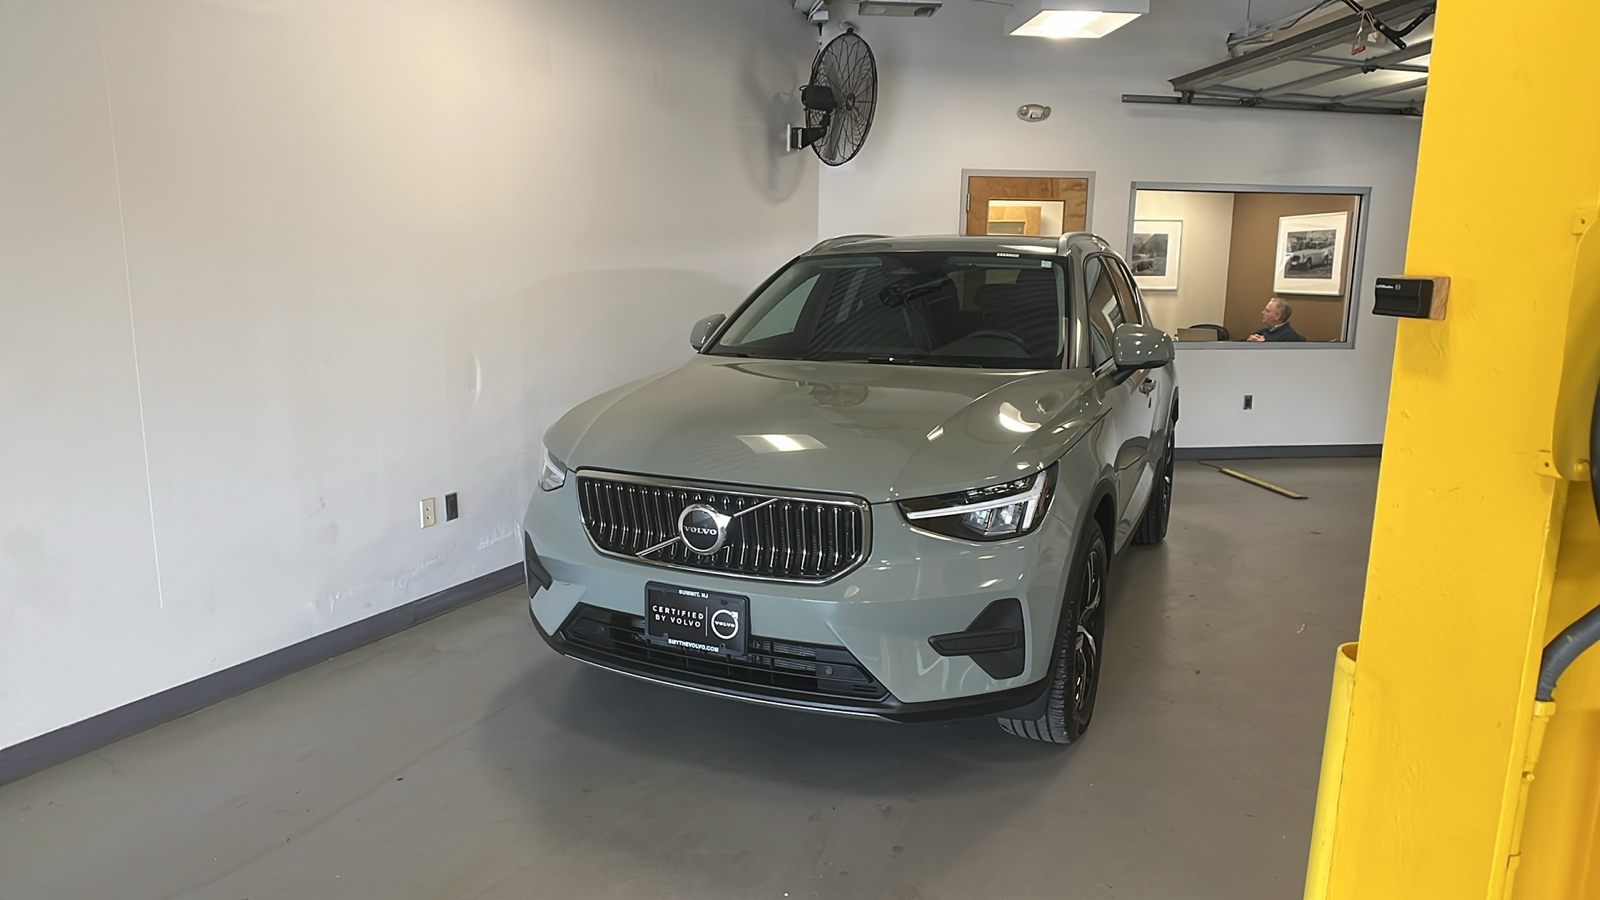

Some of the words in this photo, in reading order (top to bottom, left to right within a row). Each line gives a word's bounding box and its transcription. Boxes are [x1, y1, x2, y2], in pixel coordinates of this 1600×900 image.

[683, 525, 718, 536] VOLVO
[652, 605, 704, 620] CERTIFIED
[655, 613, 666, 622] BY
[670, 616, 701, 628] VOLVO
[714, 620, 736, 628] VOLVO
[668, 638, 719, 653] SMYTHEVOLVO.COM
